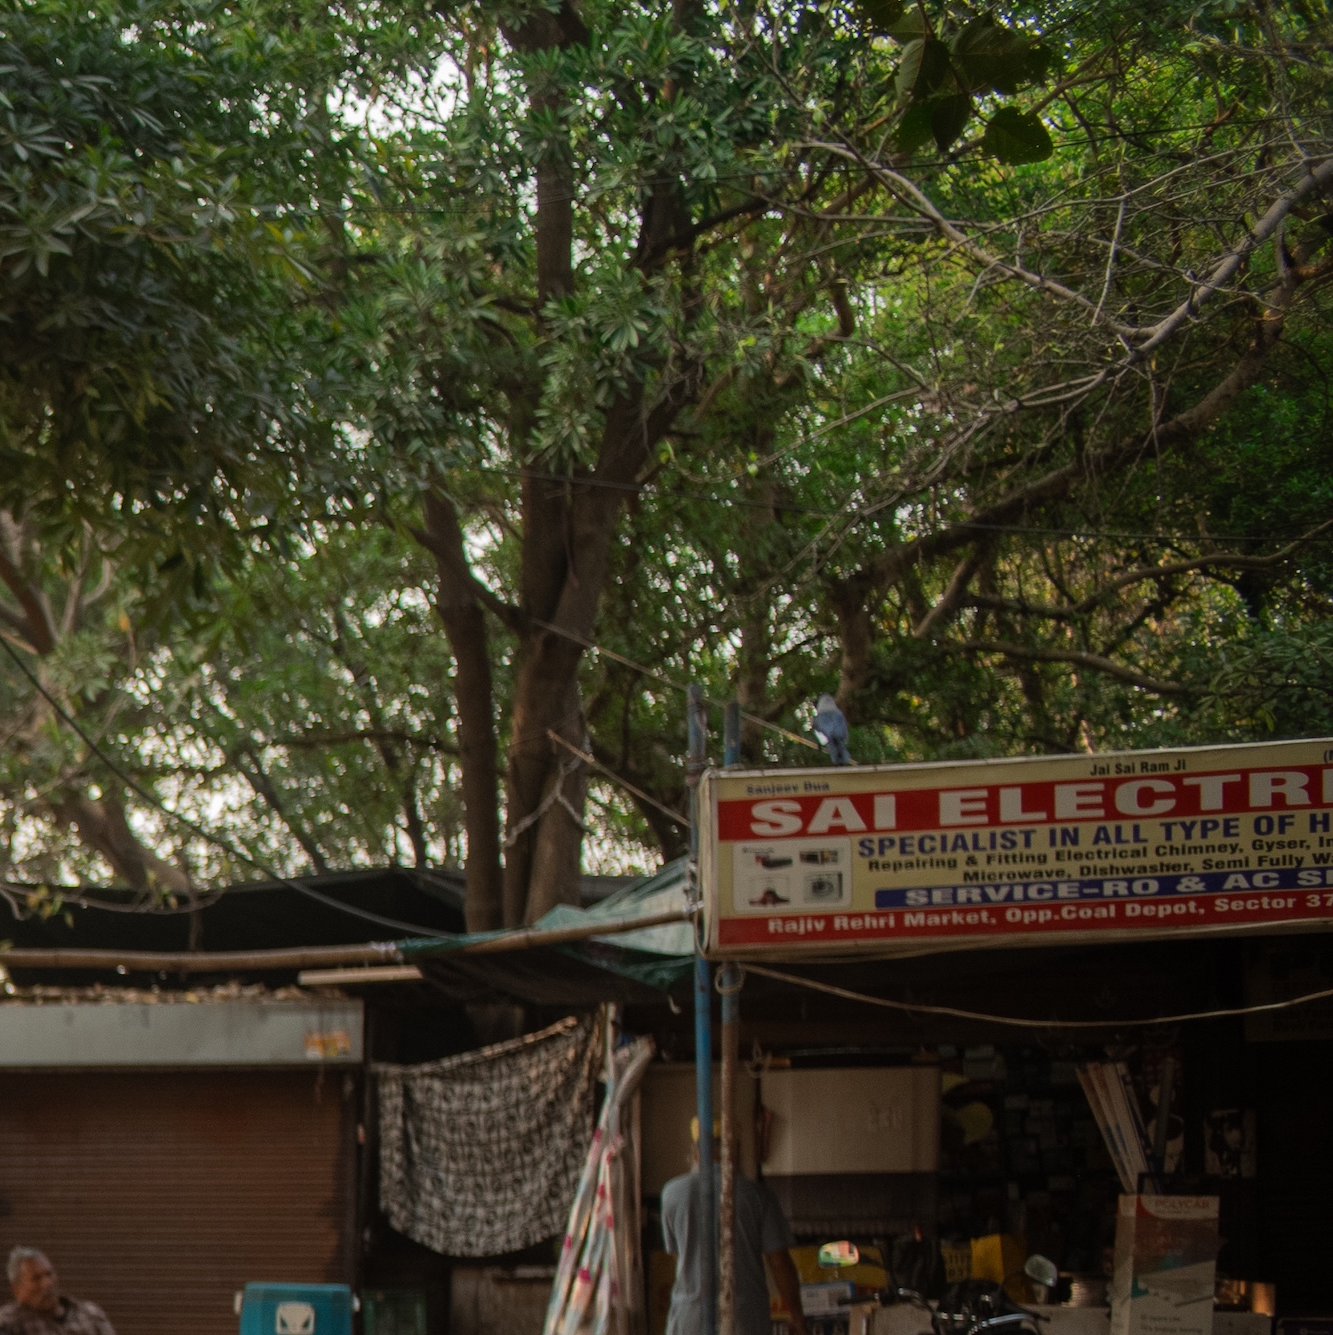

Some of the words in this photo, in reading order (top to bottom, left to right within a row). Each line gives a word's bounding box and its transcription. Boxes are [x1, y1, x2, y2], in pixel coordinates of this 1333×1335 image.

[1090, 764, 1110, 776] Jai
[1115, 763, 1135, 775] Sai
[1140, 761, 1169, 773] Ram
[1174, 759, 1186, 771] Ji
[750, 793, 896, 837] SAI
[858, 829, 1037, 858] SPECIALIST
[1049, 827, 1080, 847] IN
[1092, 824, 1148, 845] ALL
[1161, 817, 1240, 841] TYPE
[1254, 814, 1295, 836] OF
[868, 852, 958, 873] Repairing
[966, 853, 978, 867] &
[986, 848, 1047, 868] Fitting
[1055, 845, 1148, 863] Electrical
[1156, 841, 1243, 859] Chimney,
[1252, 839, 1311, 854] Gyser,
[963, 868, 1072, 884] Microwave,
[1080, 860, 1194, 878] Dishwasher,
[1203, 857, 1249, 872] Semi
[1258, 854, 1304, 868] Fully
[905, 879, 1159, 906] SERVICE-RO
[1176, 876, 1207, 893] &
[1223, 871, 1280, 890] AC
[768, 917, 826, 935] Rajiv
[834, 914, 895, 931] Rehri
[904, 908, 996, 928] Market,
[1006, 904, 1116, 924] Opp.Coal
[1125, 900, 1205, 919] Depot,
[1214, 895, 1297, 912] Sector
